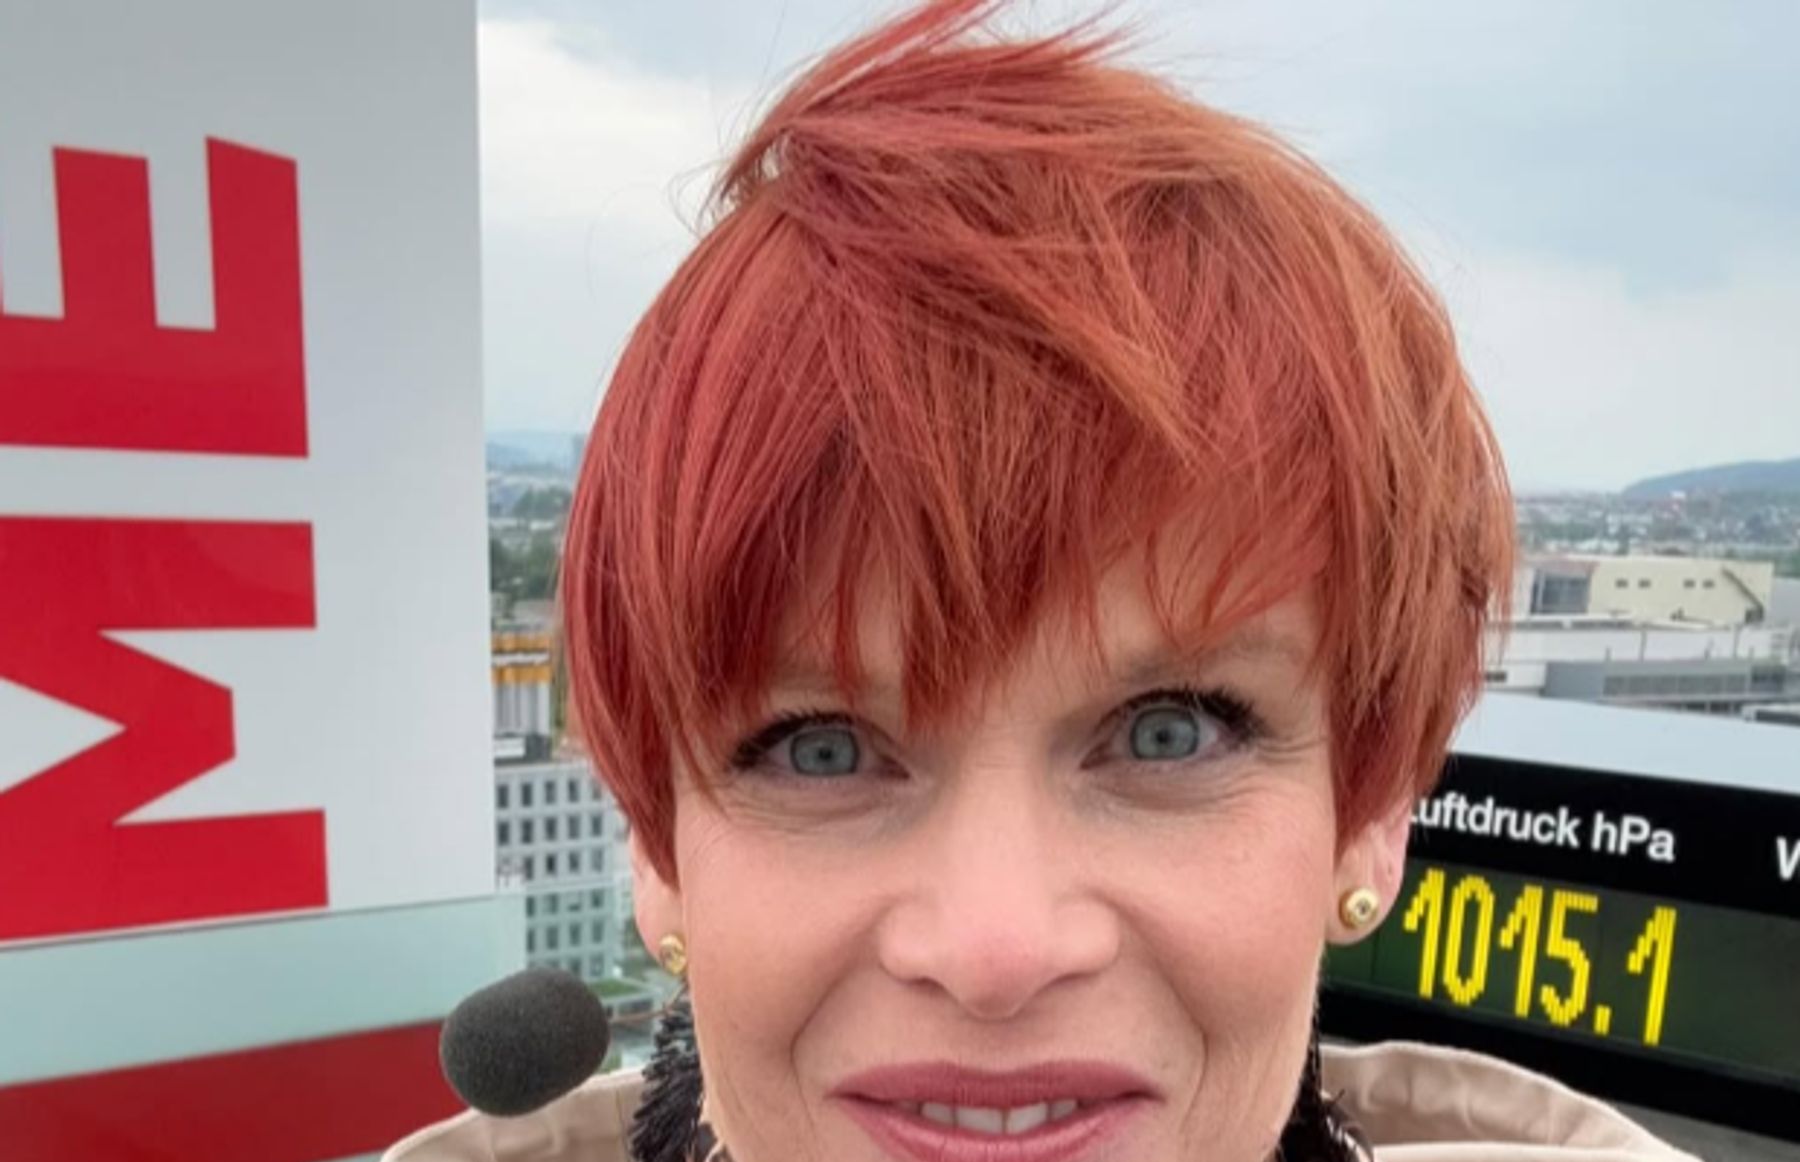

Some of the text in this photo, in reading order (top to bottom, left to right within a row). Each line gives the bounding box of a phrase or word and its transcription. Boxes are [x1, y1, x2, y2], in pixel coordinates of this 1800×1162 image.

[0, 137, 329, 940] ME
[1411, 791, 1675, 863] uftdruck hPa
[1404, 869, 1677, 1046] 1015.1
